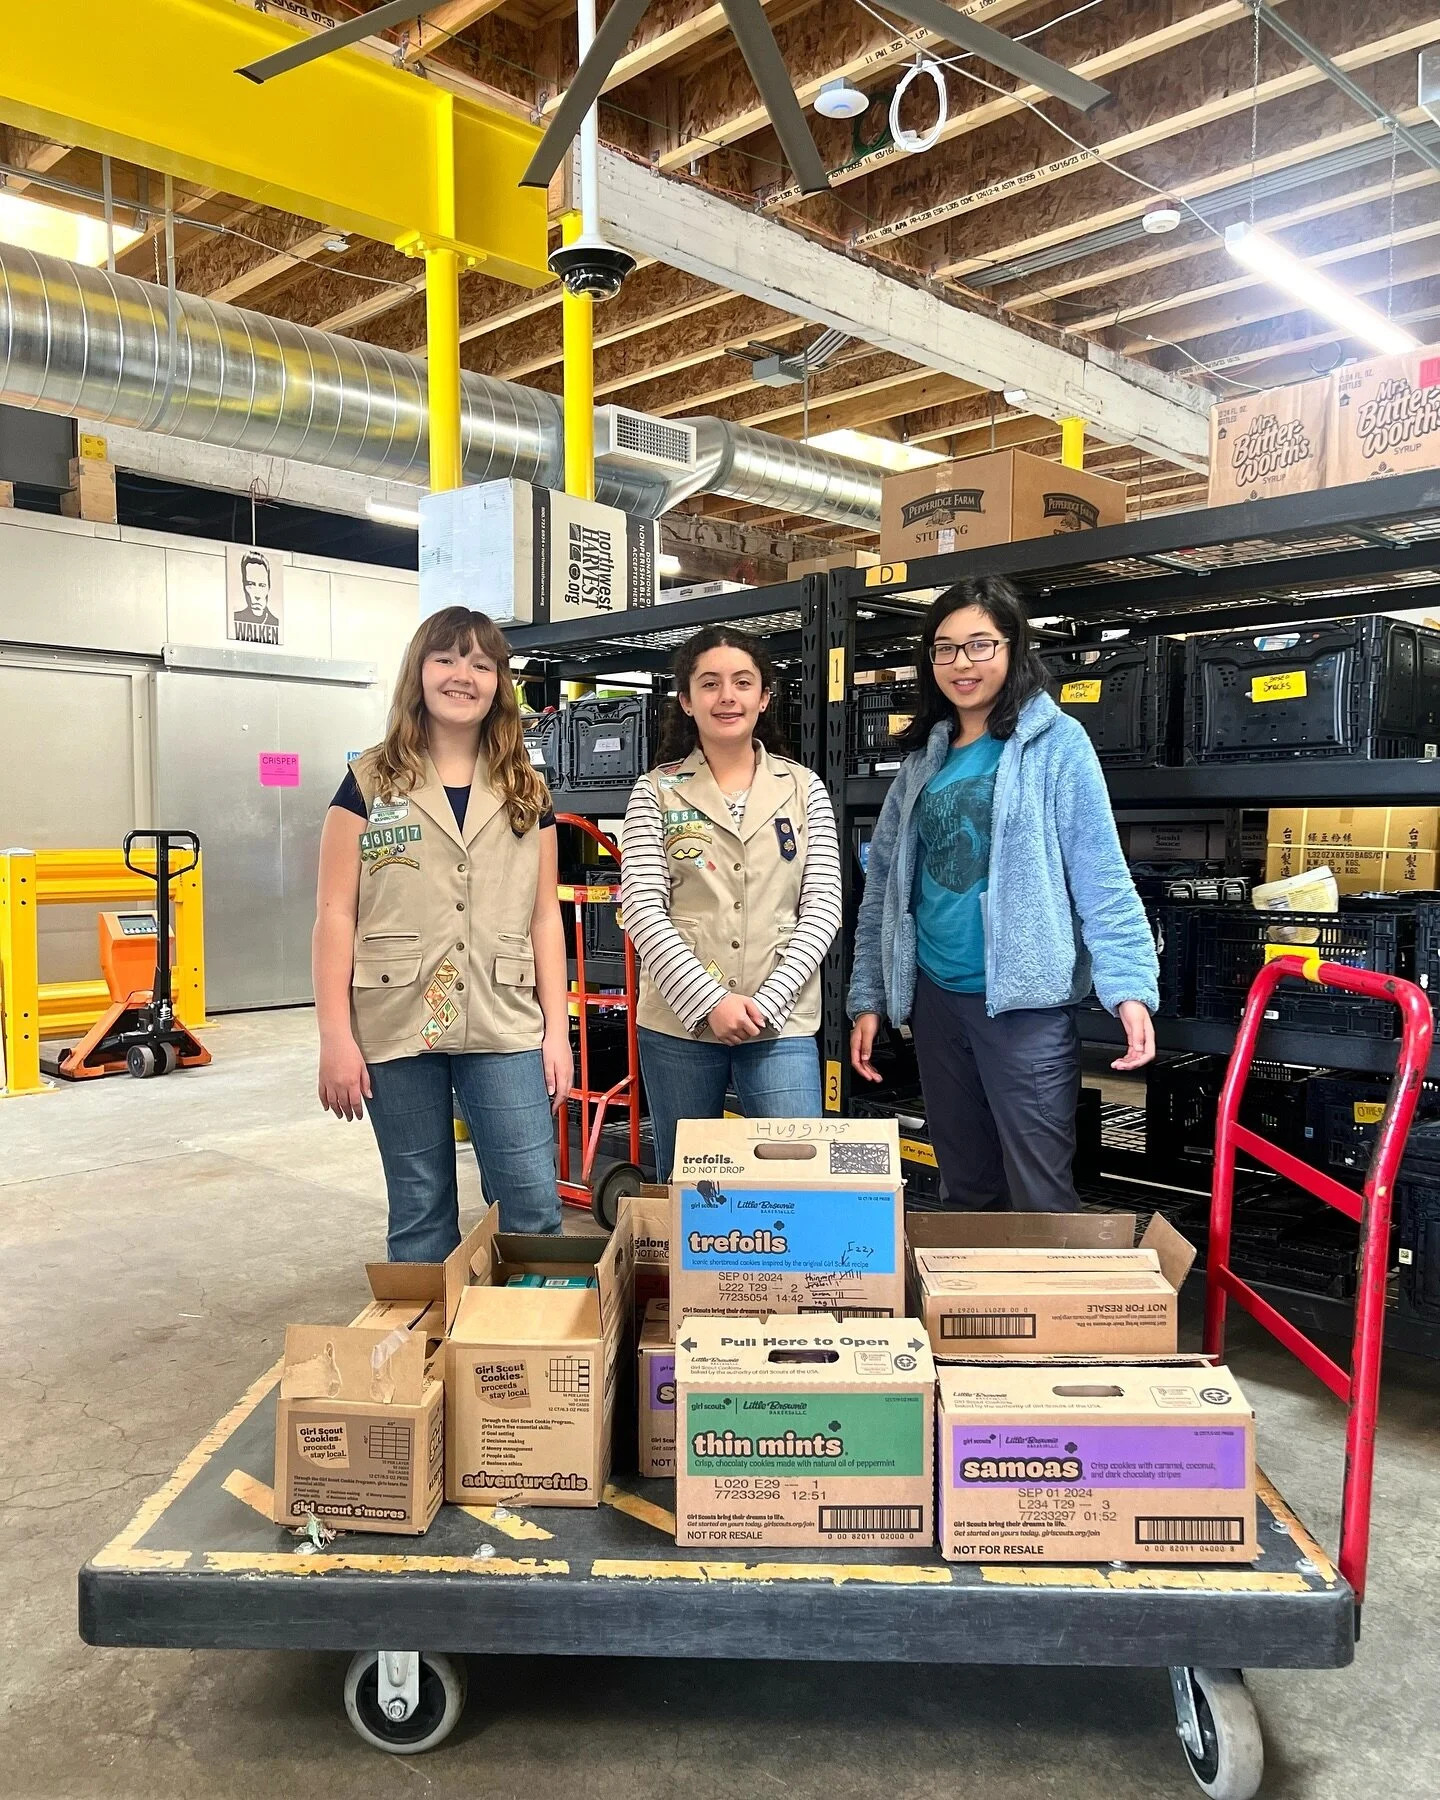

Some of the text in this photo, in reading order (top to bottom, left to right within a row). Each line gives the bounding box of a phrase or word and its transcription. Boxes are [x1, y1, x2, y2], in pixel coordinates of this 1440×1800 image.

[895, 221, 907, 231] APA
[1002, 180, 1016, 191] ASTM
[1049, 156, 1078, 172] 03/16/23
[1394, 443, 1422, 456] SYRUP
[1262, 474, 1286, 484] SYRUP
[909, 494, 975, 519] PEPPERIDGE FARM
[1048, 498, 1095, 519] PEPPERIDGE FARM
[916, 524, 968, 543] STUNG
[581, 526, 599, 608] HARVEST
[598, 530, 614, 612] northwest
[880, 566, 893, 584] D
[564, 579, 580, 605] .org
[235, 622, 279, 645] WALKEN
[834, 658, 839, 683] 1
[262, 756, 296, 766] CRISPER
[362, 827, 419, 848] 46817
[828, 1076, 838, 1102] 3
[756, 1122, 850, 1139] Huggins
[634, 1235, 669, 1250] galong
[718, 1272, 783, 1282] SEP 01 2024
[719, 1283, 744, 1292] L222
[749, 1283, 767, 1292] T29
[791, 1283, 798, 1292] 2
[719, 1294, 768, 1302] 77235054
[776, 1294, 804, 1302] 14:42
[1087, 1304, 1167, 1312] NOT FOR RESALE
[721, 1337, 889, 1347] Pull Here to Open
[496, 1364, 524, 1372] Scout
[481, 1382, 517, 1392] proceeds
[508, 1389, 530, 1397] local.
[692, 1402, 703, 1411] girl
[743, 1401, 766, 1410] Little
[769, 1401, 807, 1410] Brownie
[303, 1444, 336, 1452] proceeds
[693, 1430, 843, 1457] thin mints
[695, 1459, 714, 1468] Crisp,
[716, 1459, 747, 1468] chocolaty
[750, 1459, 775, 1468] cookies
[776, 1459, 794, 1468] made
[796, 1459, 811, 1468] with
[813, 1459, 837, 1468] natural
[848, 1459, 855, 1468] of
[856, 1459, 895, 1468] peppermint
[1091, 1462, 1216, 1470] Crisp cookies with caramel, coconut,
[960, 1458, 1082, 1482] samoas
[1091, 1471, 1181, 1479] and dark chocolaty stripes
[462, 1470, 588, 1490] adventurefuls
[715, 1479, 818, 1489] L020 E29 1
[715, 1490, 826, 1500] 77233296 12:51
[1018, 1488, 1092, 1497] SEP 01 2024
[292, 1500, 315, 1515] girl
[317, 1503, 352, 1516] scout
[1019, 1500, 1110, 1509] L234 T29 3
[1020, 1512, 1117, 1521] 77233297 01:52
[687, 1531, 763, 1540] NOT FOR RESALE
[954, 1545, 1044, 1554] NOT FOR RESALE
